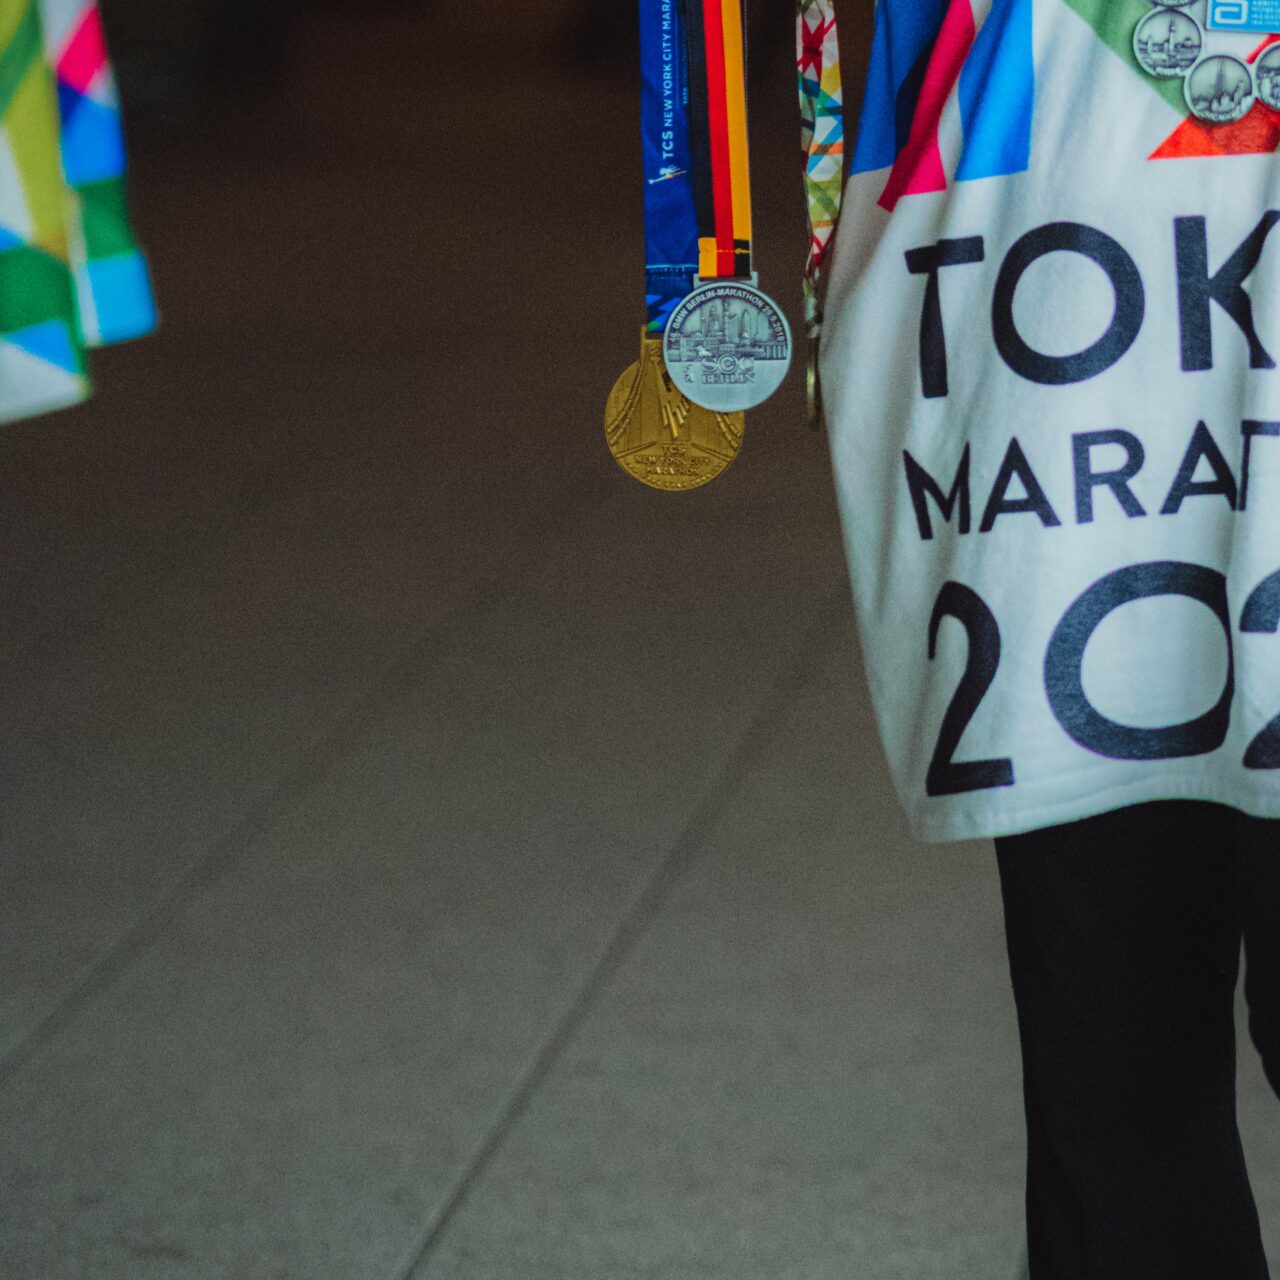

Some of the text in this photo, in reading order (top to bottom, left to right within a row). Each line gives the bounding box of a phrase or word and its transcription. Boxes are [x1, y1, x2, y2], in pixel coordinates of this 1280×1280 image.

[662, 33, 673, 61] CITY
[663, 63, 673, 96] YORK
[664, 100, 674, 127] NEW
[662, 131, 674, 160] TCS
[673, 308, 688, 329] BMW
[686, 288, 763, 309] BERLIN-MARATHON
